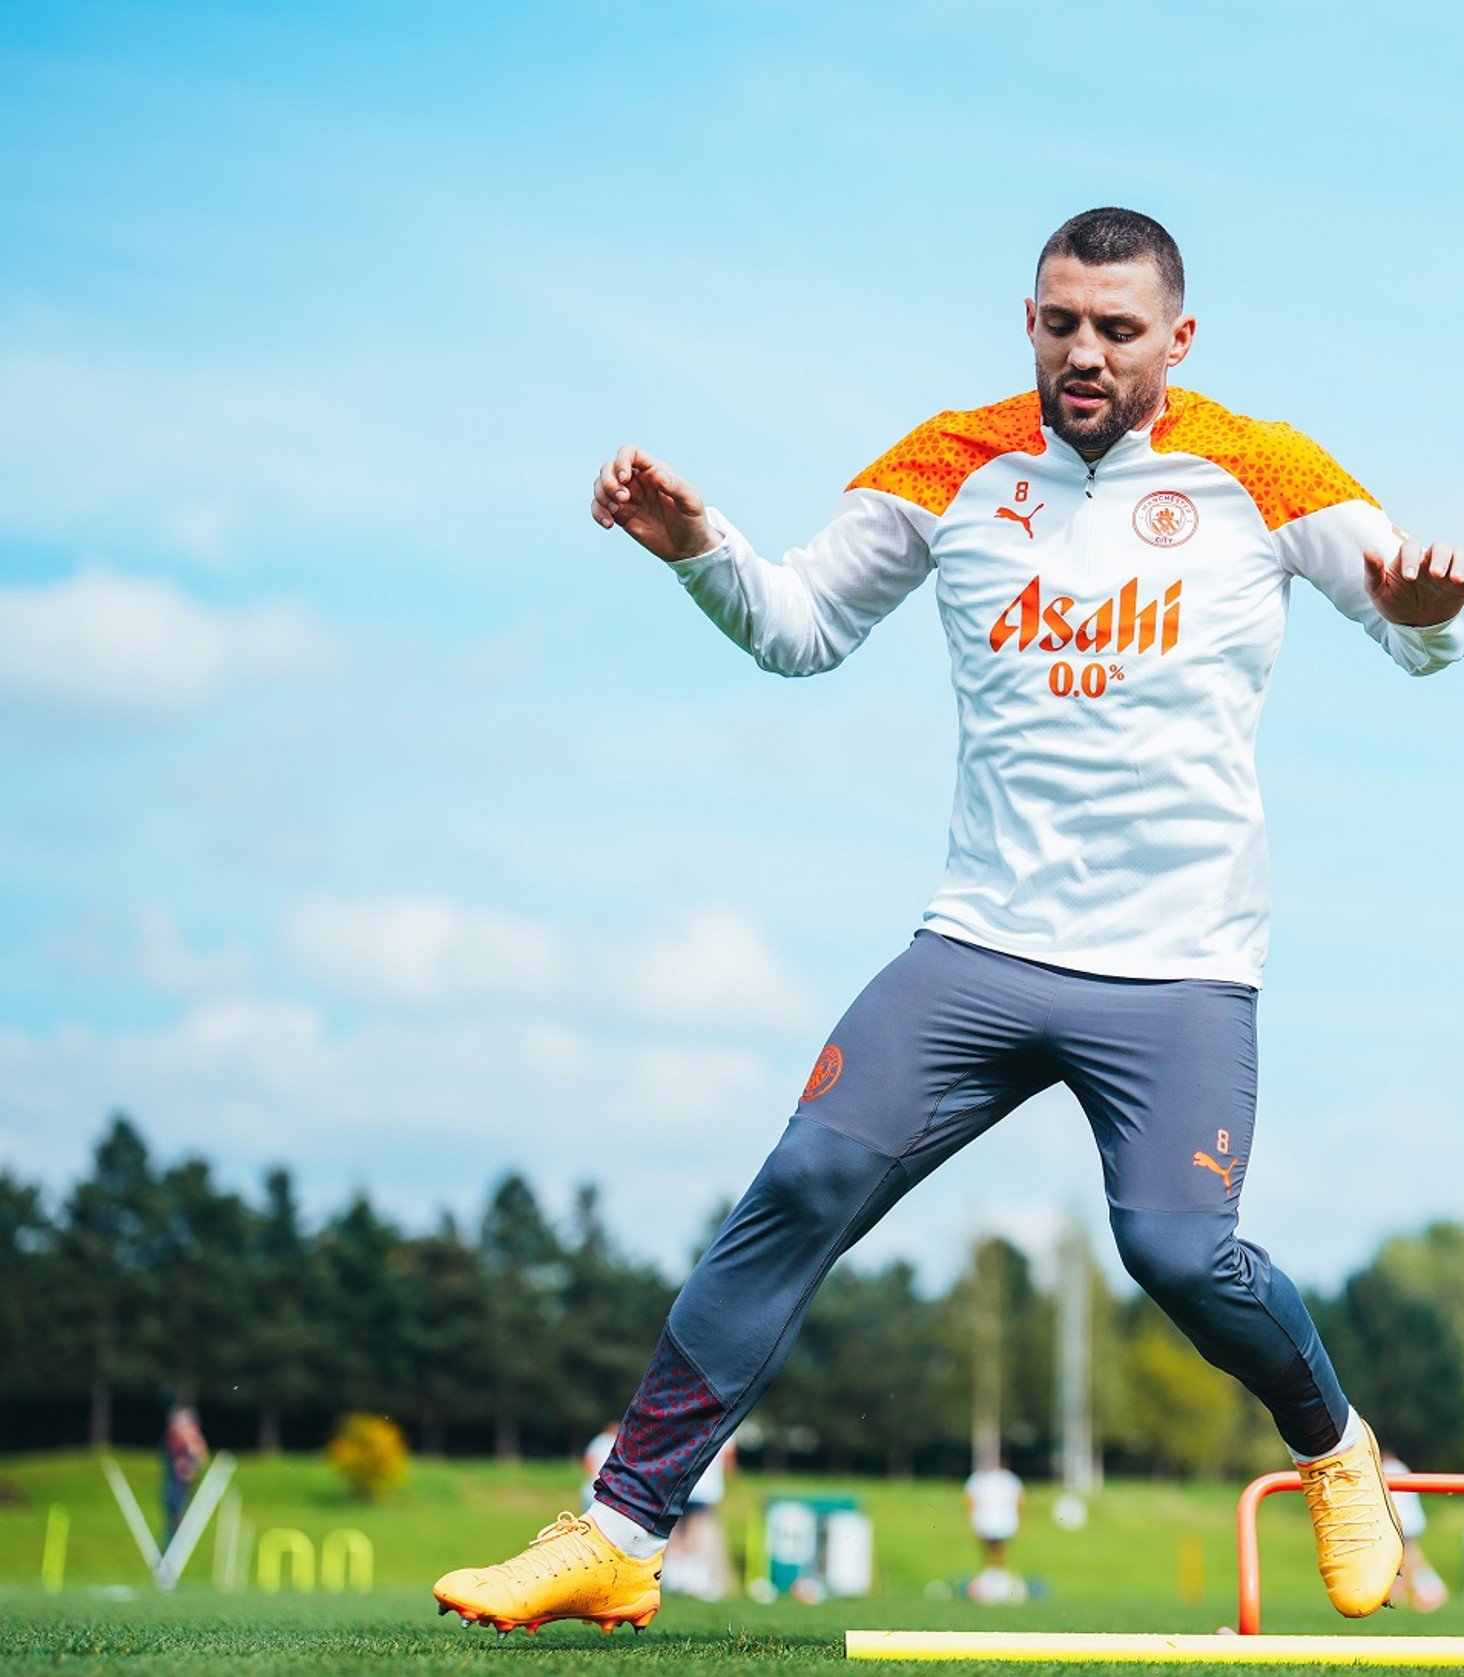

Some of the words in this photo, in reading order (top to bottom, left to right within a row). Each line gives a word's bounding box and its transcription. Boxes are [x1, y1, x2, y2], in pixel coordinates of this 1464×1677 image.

[1015, 481, 1029, 502] 8
[1142, 495, 1192, 514] MANCHESTER
[1155, 536, 1174, 544] CITY
[988, 575, 1183, 656] Asahi
[1048, 661, 1126, 698] 0.0%
[1217, 1129, 1229, 1154] 8
